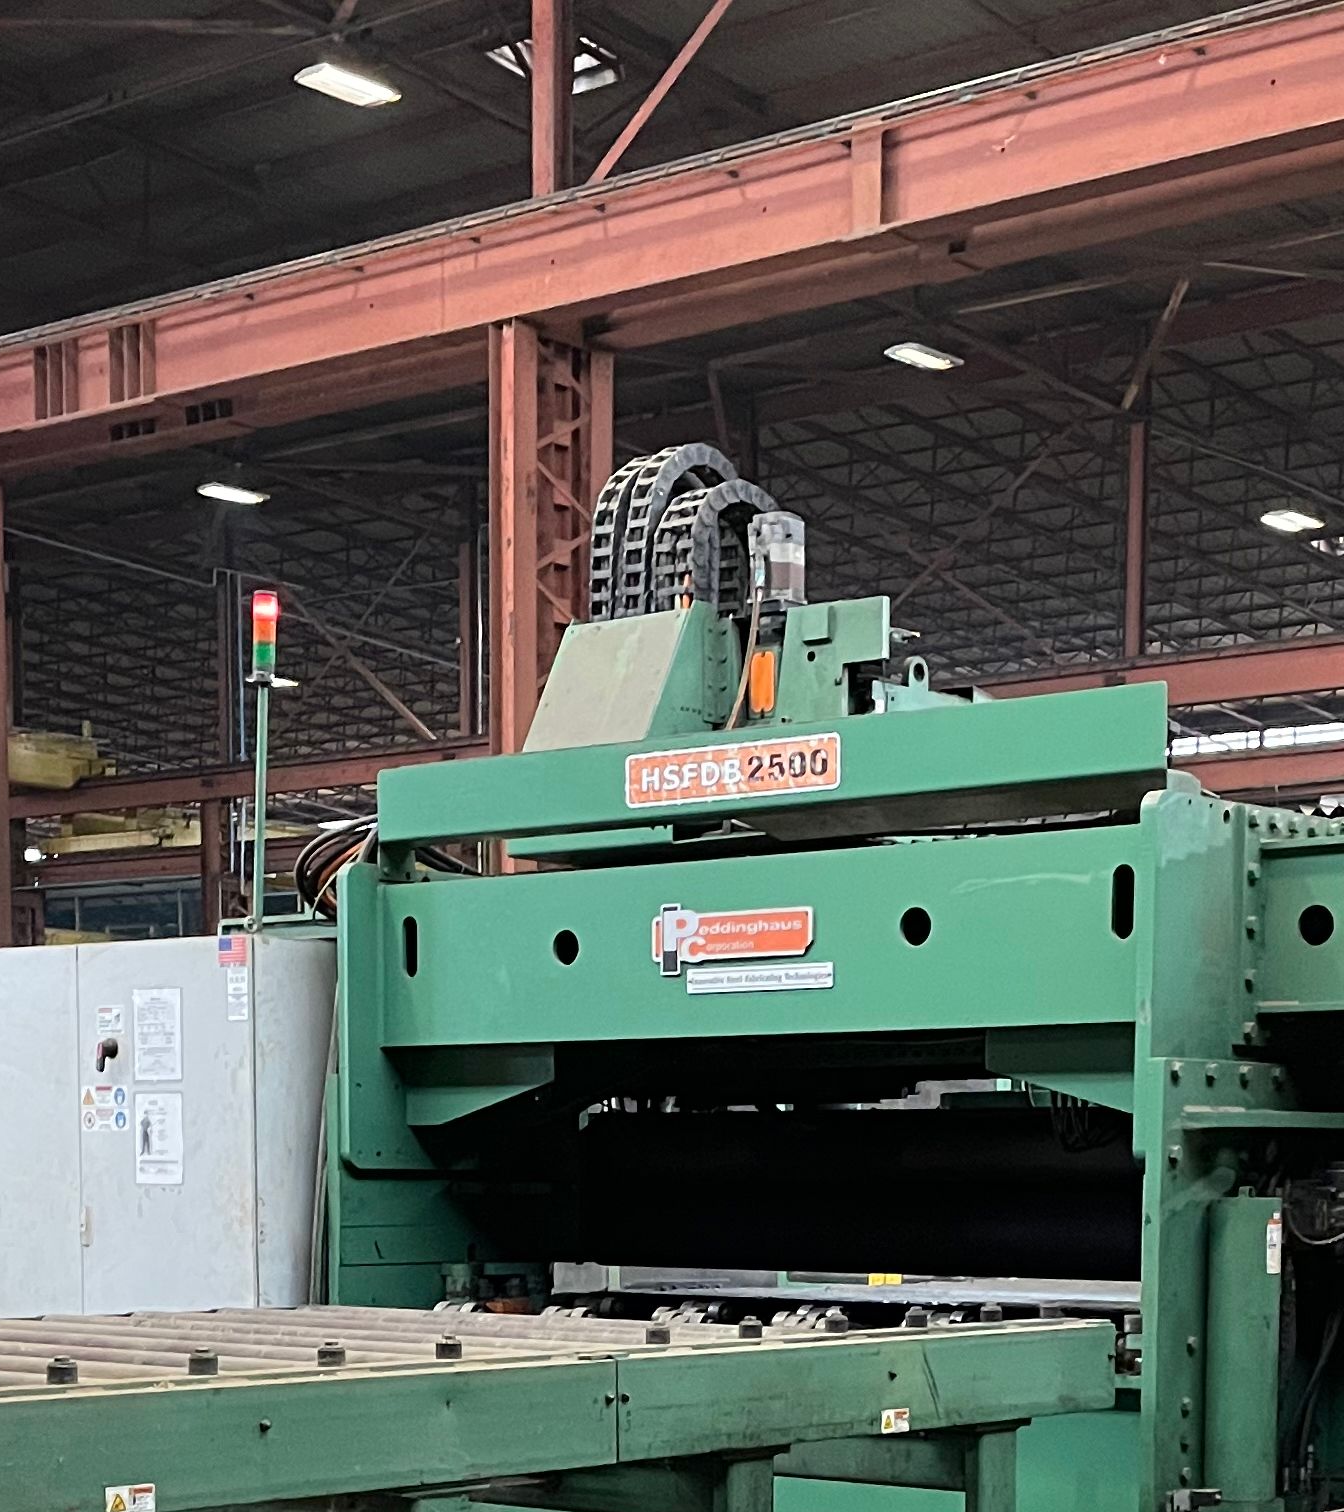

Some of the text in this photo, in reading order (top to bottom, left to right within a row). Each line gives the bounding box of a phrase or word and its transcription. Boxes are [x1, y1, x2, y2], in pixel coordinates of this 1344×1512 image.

[641, 748, 828, 792] HSFDB 2500
[663, 909, 803, 951] Peddinghaus
